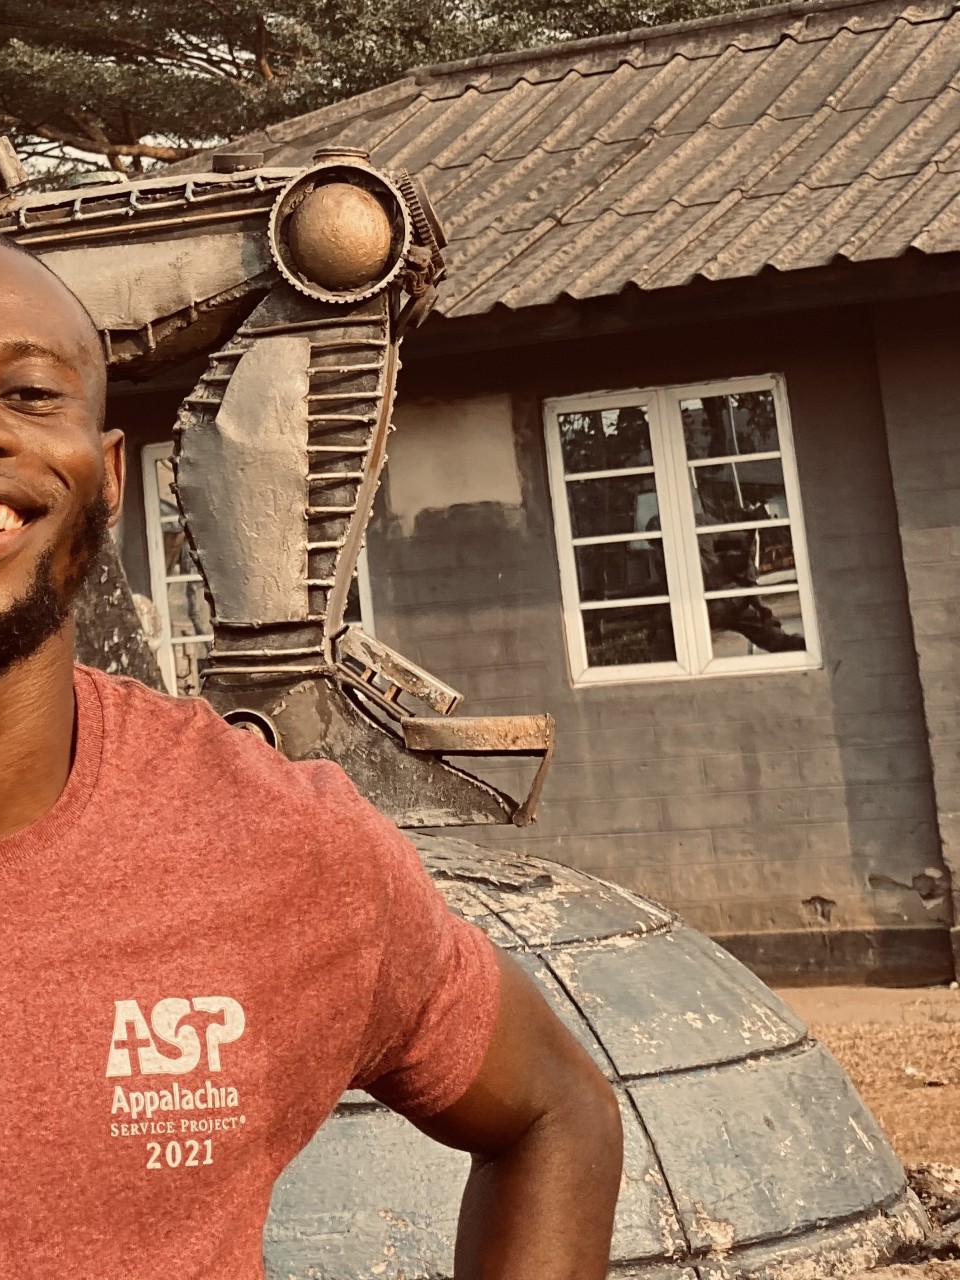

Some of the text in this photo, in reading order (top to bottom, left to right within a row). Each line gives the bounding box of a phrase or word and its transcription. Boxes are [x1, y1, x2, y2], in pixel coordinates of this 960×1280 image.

[105, 995, 247, 1078] ASP
[110, 1080, 240, 1120] Appalachia
[110, 1121, 176, 1138] SERVICE
[146, 1138, 215, 1170] 2021
